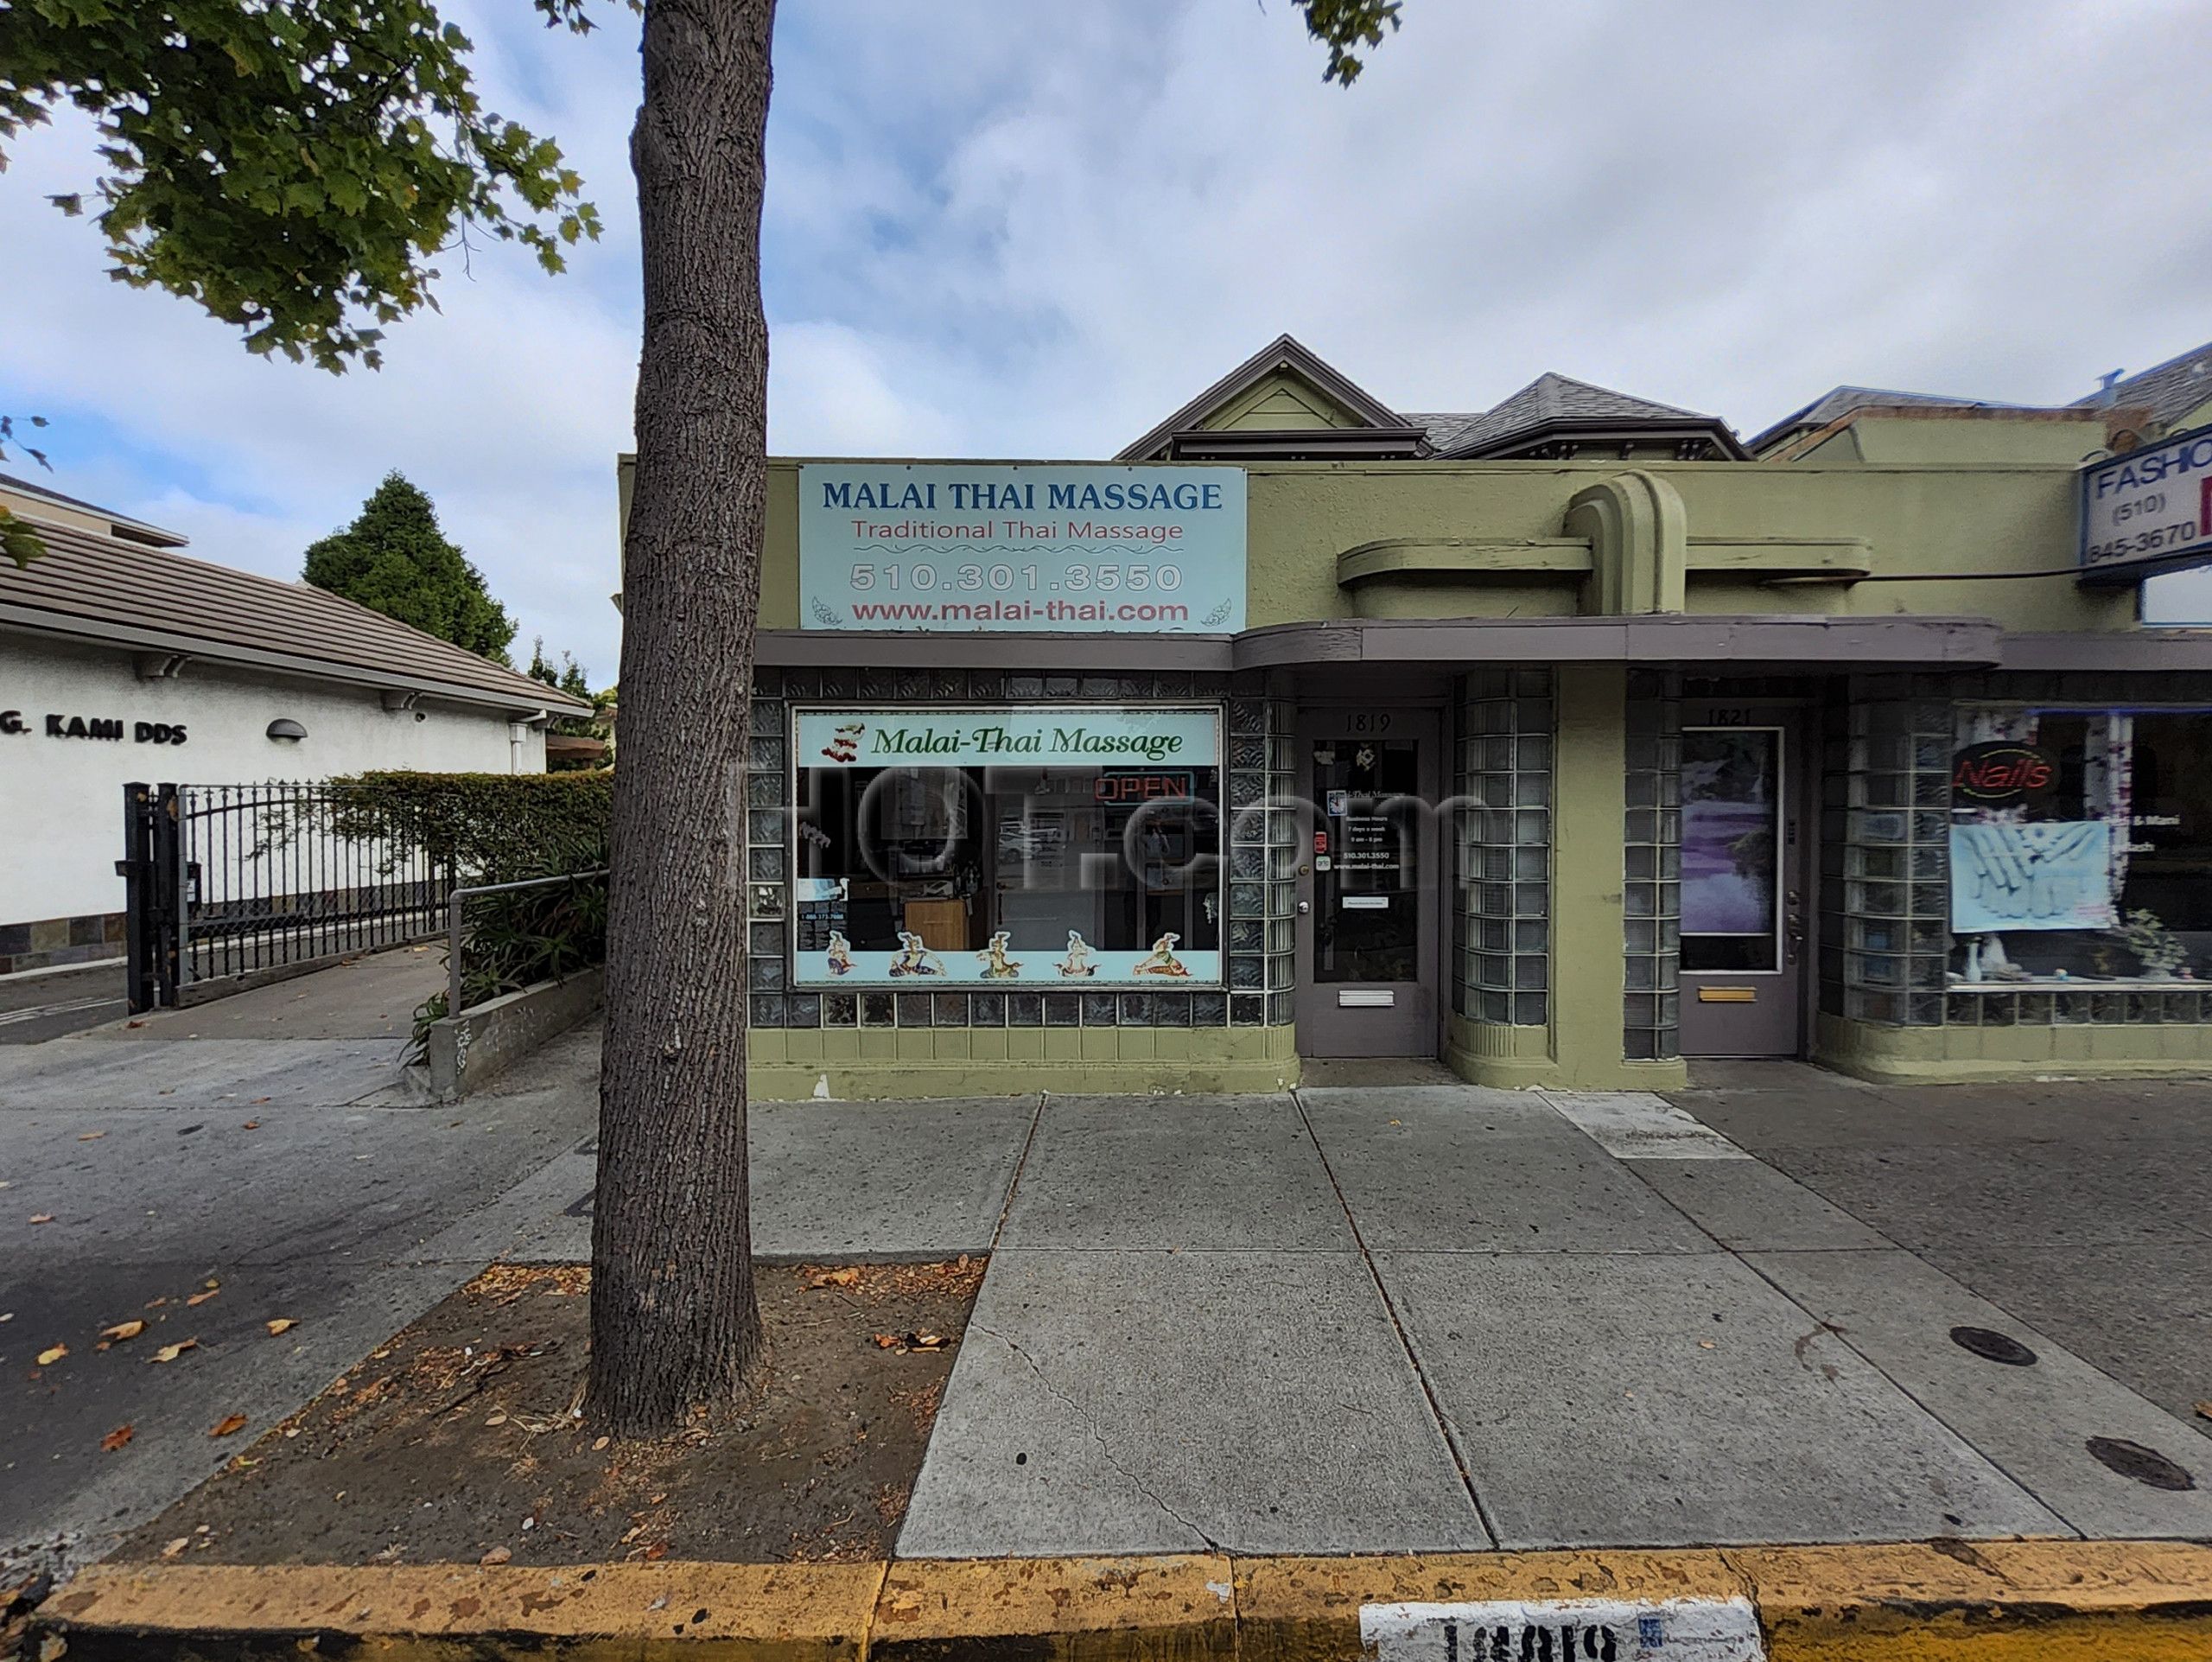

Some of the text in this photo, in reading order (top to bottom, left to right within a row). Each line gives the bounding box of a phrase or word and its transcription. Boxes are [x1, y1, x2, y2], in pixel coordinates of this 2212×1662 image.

[822, 483, 1223, 511] MALAI THAI MASSAGE
[2112, 493, 2166, 526] (510)
[850, 520, 1184, 544] Traditional Thai Massage
[2089, 521, 2196, 563] 845-3670
[849, 564, 1184, 592] 510.301.3550
[852, 600, 1189, 622] www.malai-thai.com
[1346, 713, 1391, 733] 1819
[1707, 708, 1751, 726] 1821
[134, 721, 188, 746] DDS
[870, 726, 1184, 761] Malai-Thai Massage
[1951, 759, 2053, 788] Nails
[1095, 776, 1186, 799] OPEN
